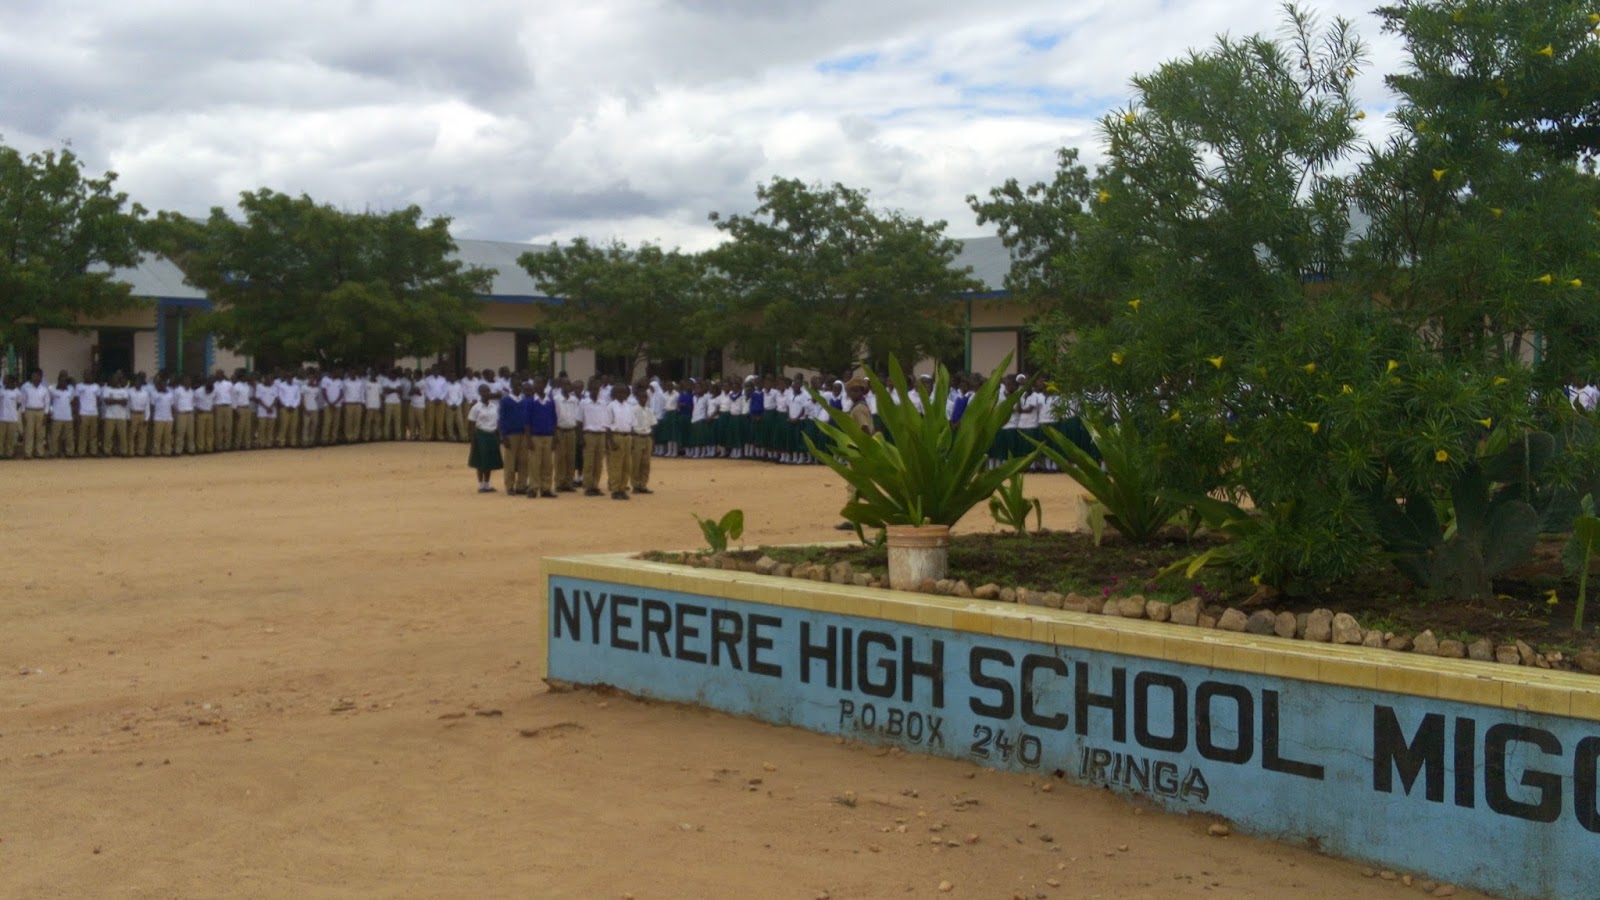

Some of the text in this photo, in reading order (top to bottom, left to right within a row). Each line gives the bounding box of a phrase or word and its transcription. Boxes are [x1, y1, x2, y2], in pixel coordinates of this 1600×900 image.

[553, 587, 782, 677] NYERERE
[800, 621, 944, 708] HIGH
[968, 645, 1324, 780] SCHOOL
[970, 724, 1042, 768] 240
[1079, 746, 1209, 804] IRINGA
